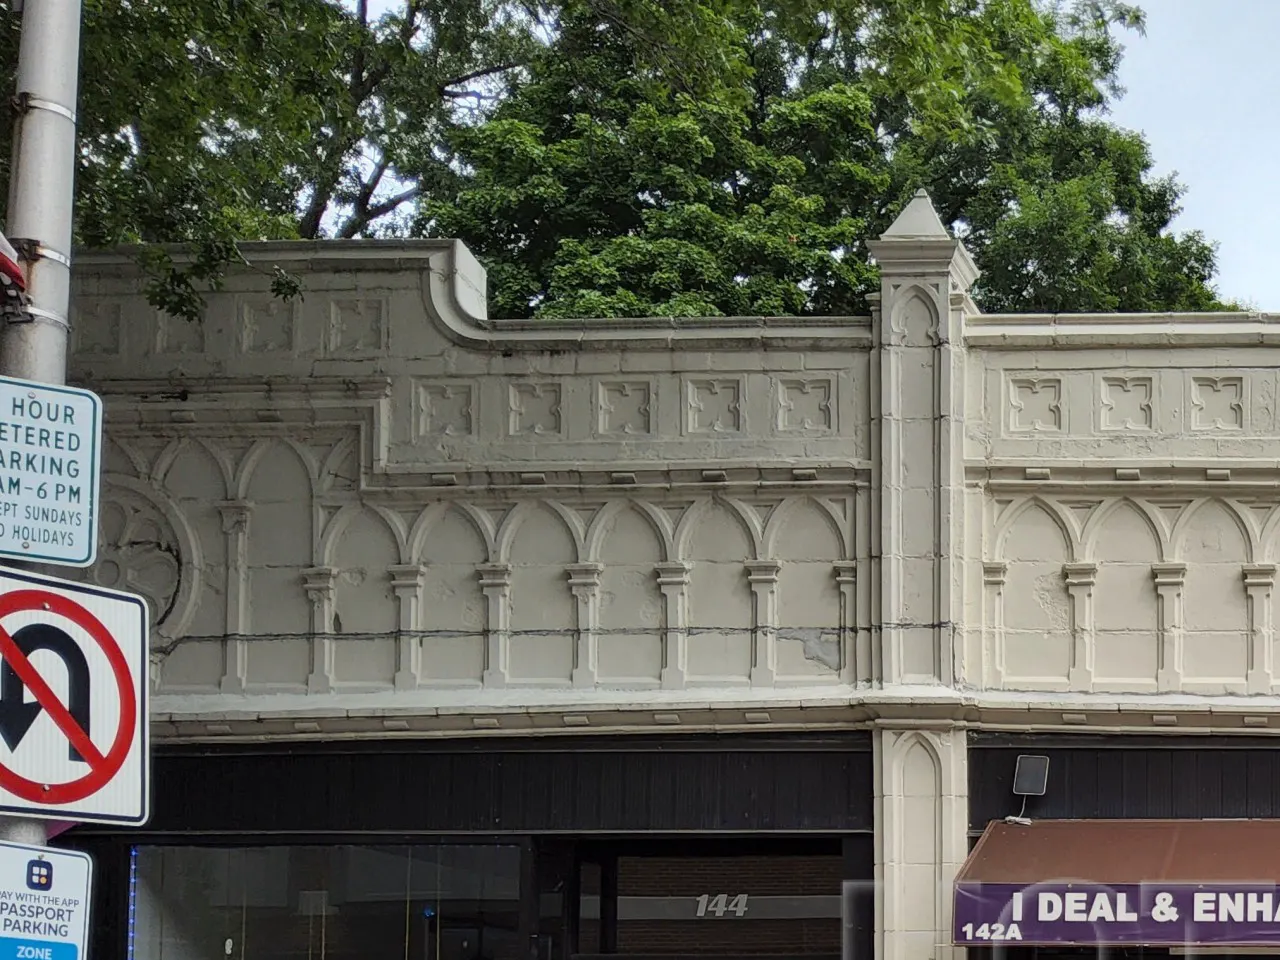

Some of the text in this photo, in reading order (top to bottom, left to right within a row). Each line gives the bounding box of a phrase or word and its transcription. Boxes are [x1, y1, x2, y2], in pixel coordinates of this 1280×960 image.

[12, 397, 75, 425] HOUR
[55, 483, 81, 504] PM
[24, 505, 82, 527] SUNDAYS
[12, 525, 74, 547] HOLIDAYS
[0, 890, 80, 908] AY WITH THE APP
[696, 893, 749, 917] 144
[1012, 892, 1023, 921] I
[1038, 892, 1138, 922] DEAL
[1151, 892, 1179, 922] &
[0, 901, 74, 922] PASSPORT
[3, 918, 69, 937] PARKING
[962, 923, 1022, 940] 142A
[16, 945, 52, 960] ZONE
